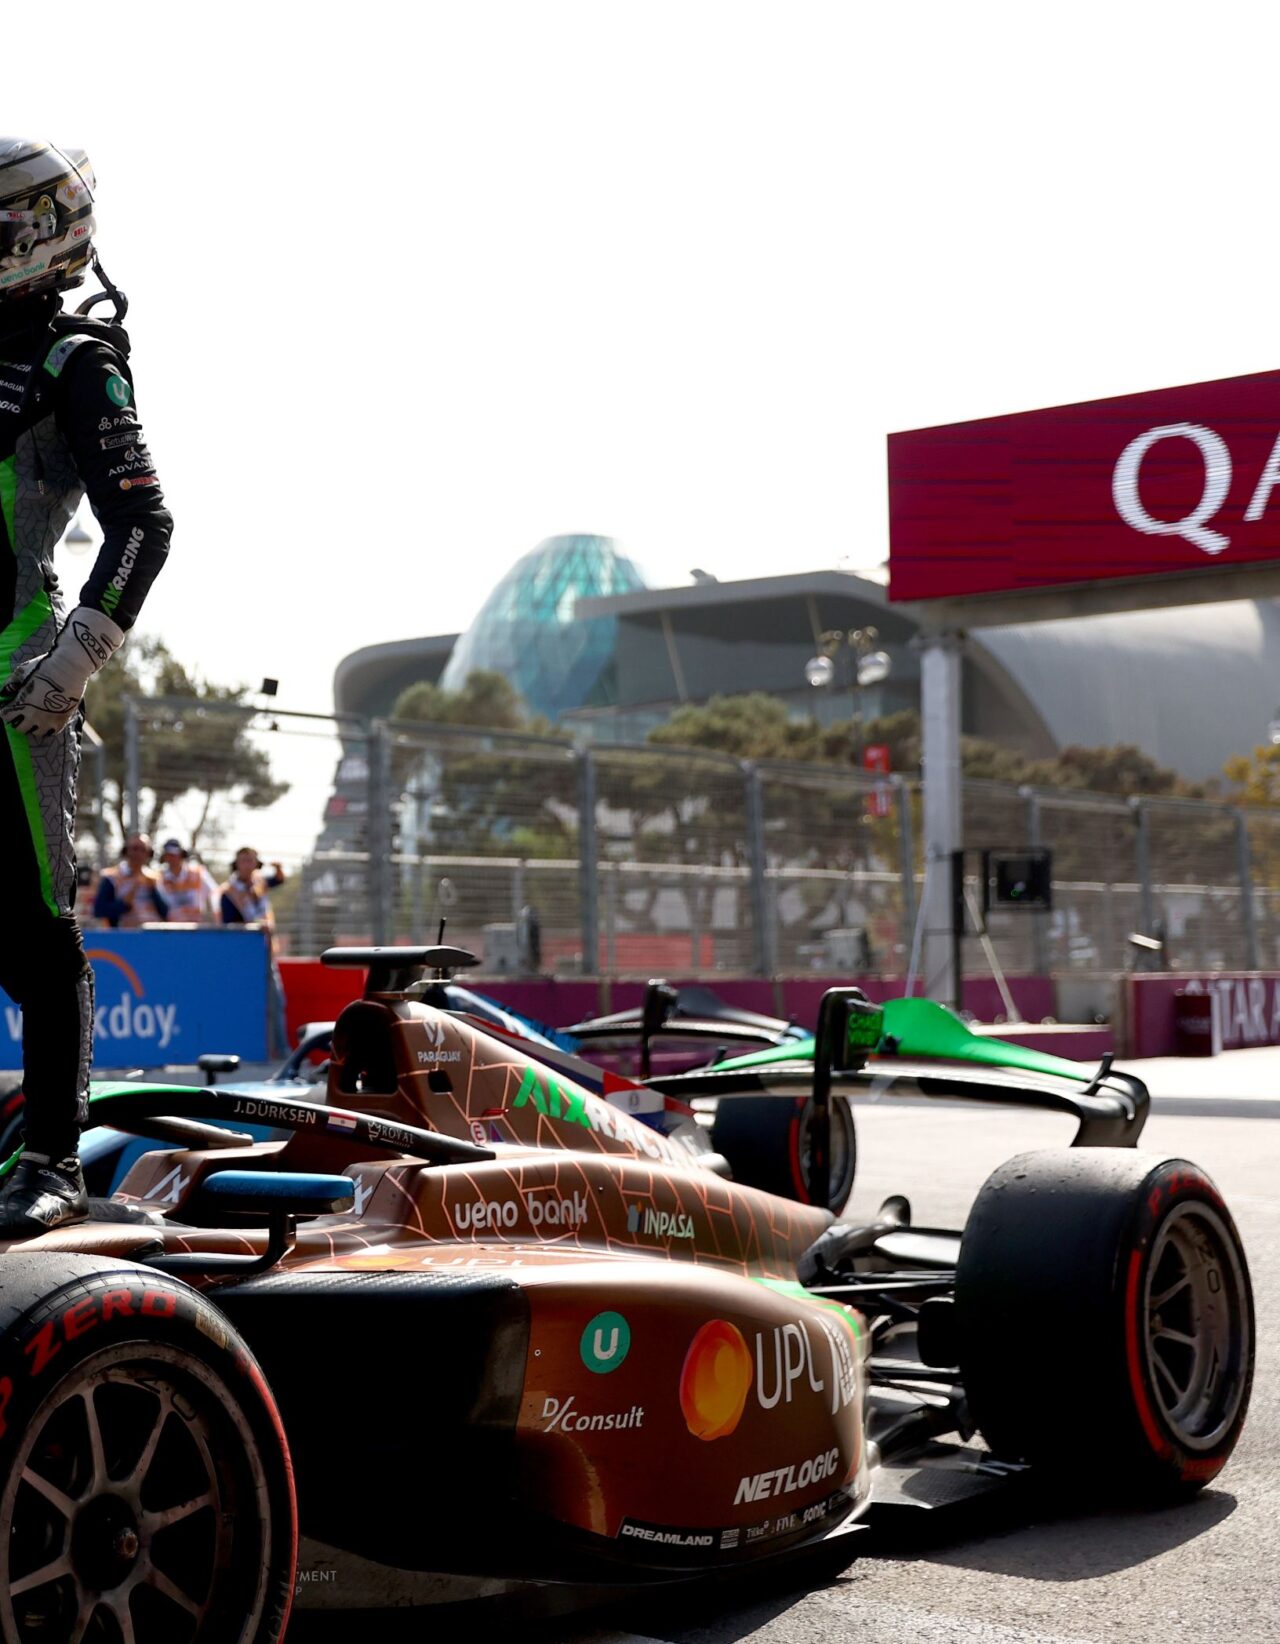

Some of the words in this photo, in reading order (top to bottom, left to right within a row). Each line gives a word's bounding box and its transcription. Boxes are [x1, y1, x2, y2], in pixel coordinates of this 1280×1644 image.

[1, 270, 24, 284] ueno
[23, 262, 46, 276] bank
[5, 992, 176, 1048] wkday
[417, 1051, 461, 1063] PARAGUAY
[381, 1126, 415, 1144] ROYAL
[455, 1200, 518, 1230] ueno
[528, 1190, 588, 1226] bank
[643, 1207, 696, 1239] INPASA
[24, 1289, 177, 1377] ZERO
[756, 1319, 824, 1410] UPL
[733, 1447, 839, 1505] NETLOGIC
[621, 1524, 714, 1546] DREAMLAND
